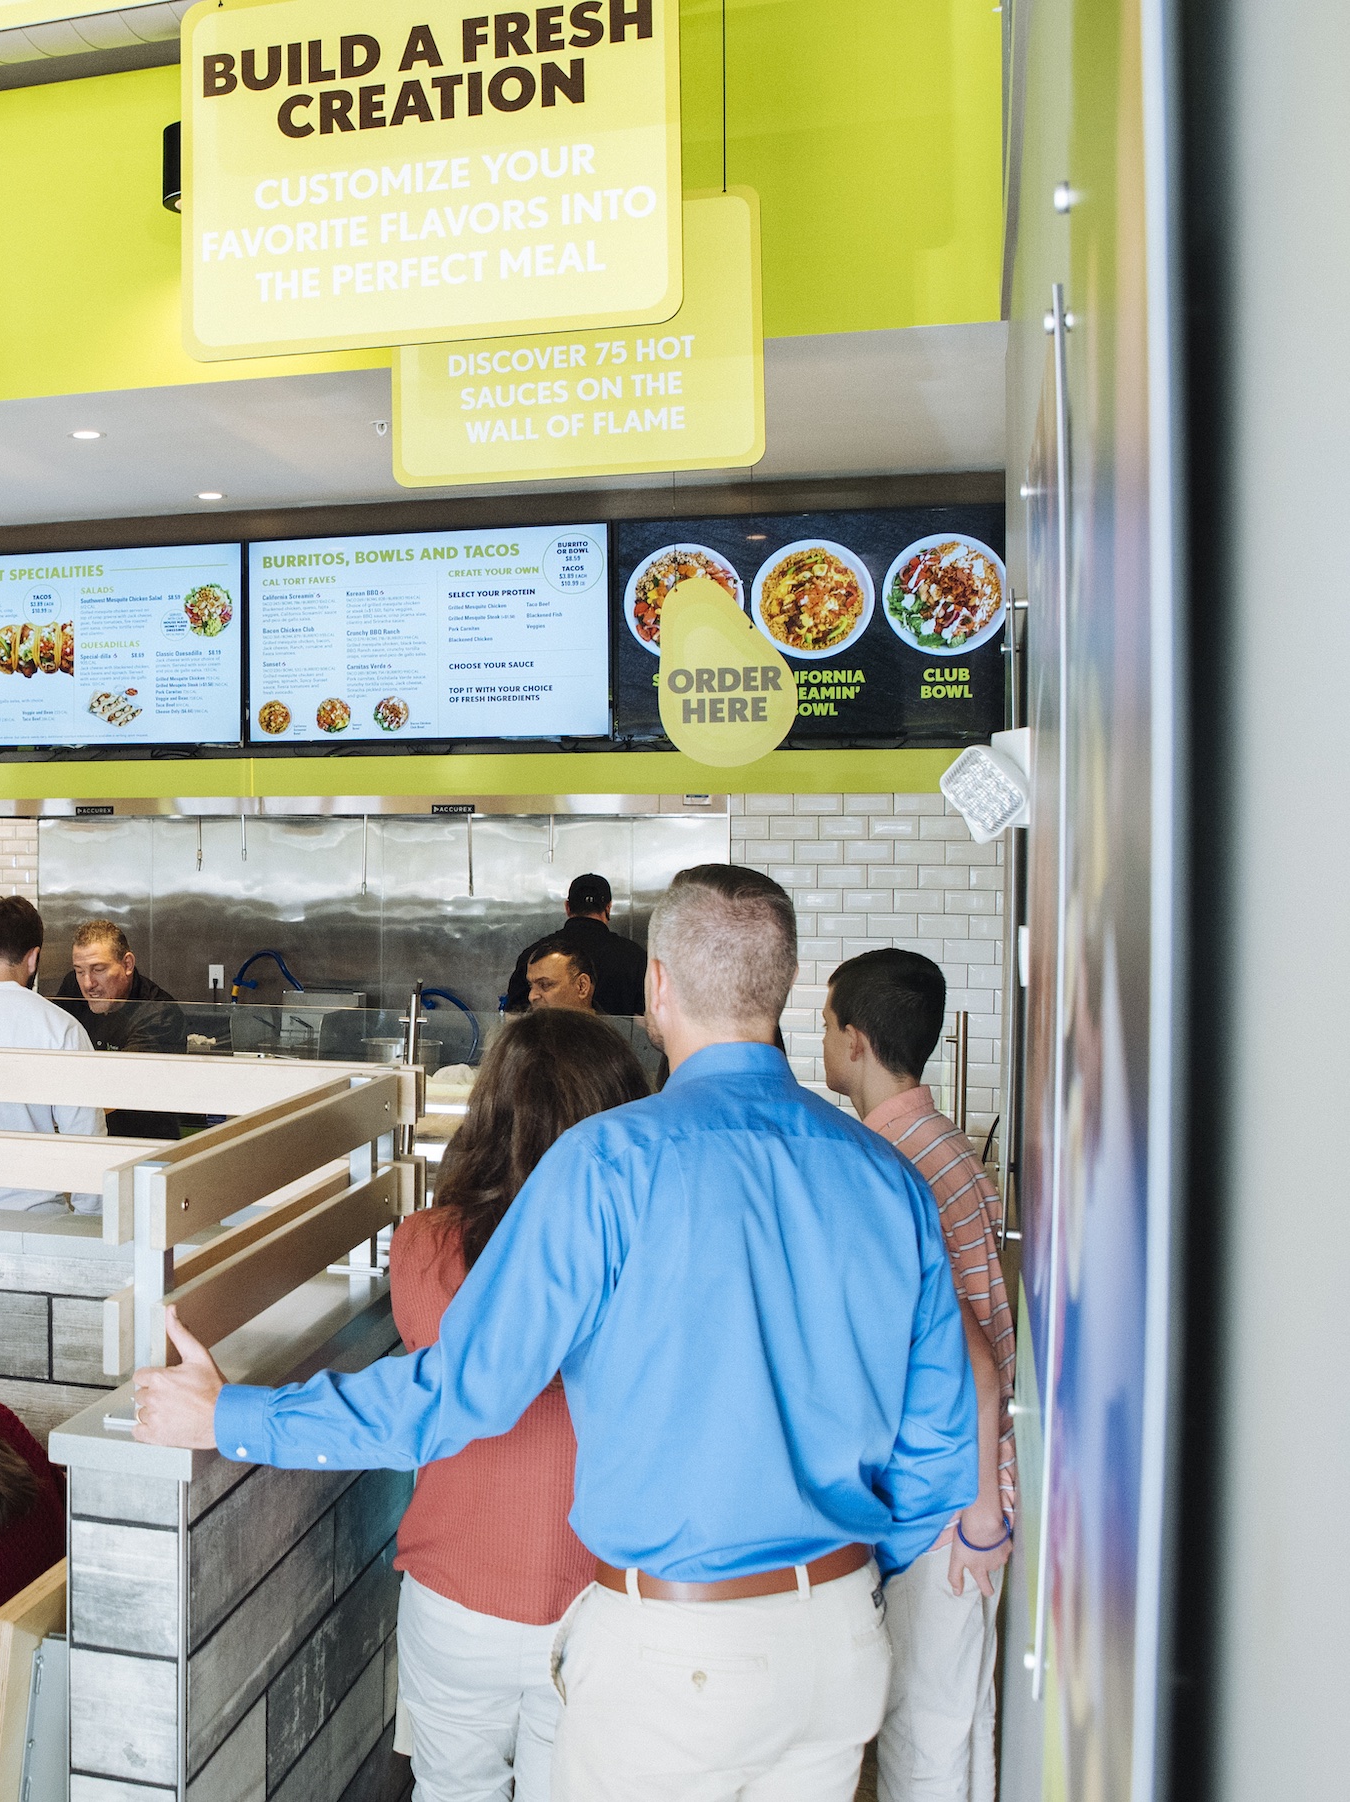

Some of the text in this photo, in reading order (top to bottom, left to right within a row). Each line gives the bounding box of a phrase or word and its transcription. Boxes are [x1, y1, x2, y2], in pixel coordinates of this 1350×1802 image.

[202, 0, 654, 98] BUILD A FRESH
[277, 57, 585, 139] CREATION
[254, 143, 595, 210] CUSTOMIZE YOUR
[201, 185, 657, 262] FAVORITE FLAVORS INTO
[255, 240, 607, 303] THE PERFECT MEAL
[448, 335, 695, 378] DISCOVER 75 HOT
[460, 371, 683, 410] SAUCES ON THE
[465, 406, 686, 444] WALL OF FLAME
[262, 543, 520, 568] BURRITOS, BOWLS AND TACOS
[9, 565, 104, 581] SPECIALITIES
[262, 576, 336, 587] CAL TORT FAVES
[448, 567, 539, 577] CREATE YOUR OWN
[81, 586, 114, 594] SALADS
[501, 588, 536, 596] PROTEIN
[81, 640, 140, 649] QUESADILLAS
[449, 662, 482, 670] CHOOSE
[923, 668, 970, 682] CLUB
[522, 684, 553, 692] CHOICE
[667, 666, 783, 694] ORDER
[461, 695, 486, 703] FRESH
[487, 694, 540, 702] INGREDIENTS
[921, 685, 973, 699] BOWL
[682, 697, 768, 724] HERE
